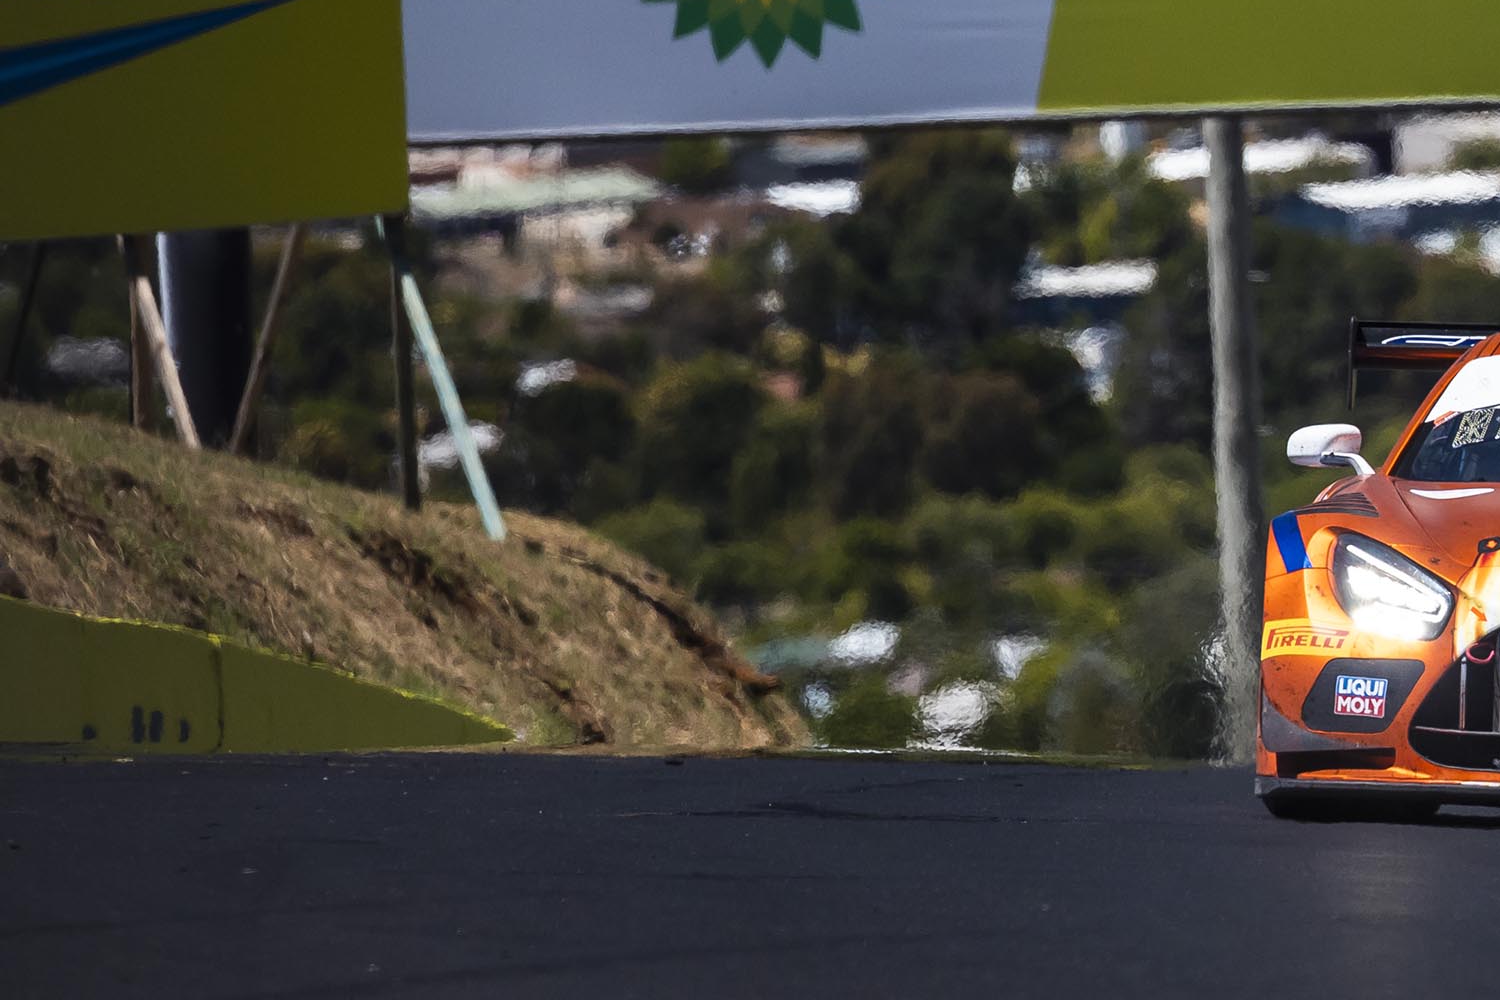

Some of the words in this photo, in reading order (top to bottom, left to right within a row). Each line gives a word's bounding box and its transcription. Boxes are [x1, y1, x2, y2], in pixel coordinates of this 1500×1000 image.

[1266, 626, 1350, 651] PIRELLI
[1338, 677, 1385, 697] LIQUI
[1336, 696, 1383, 715] MOLY
